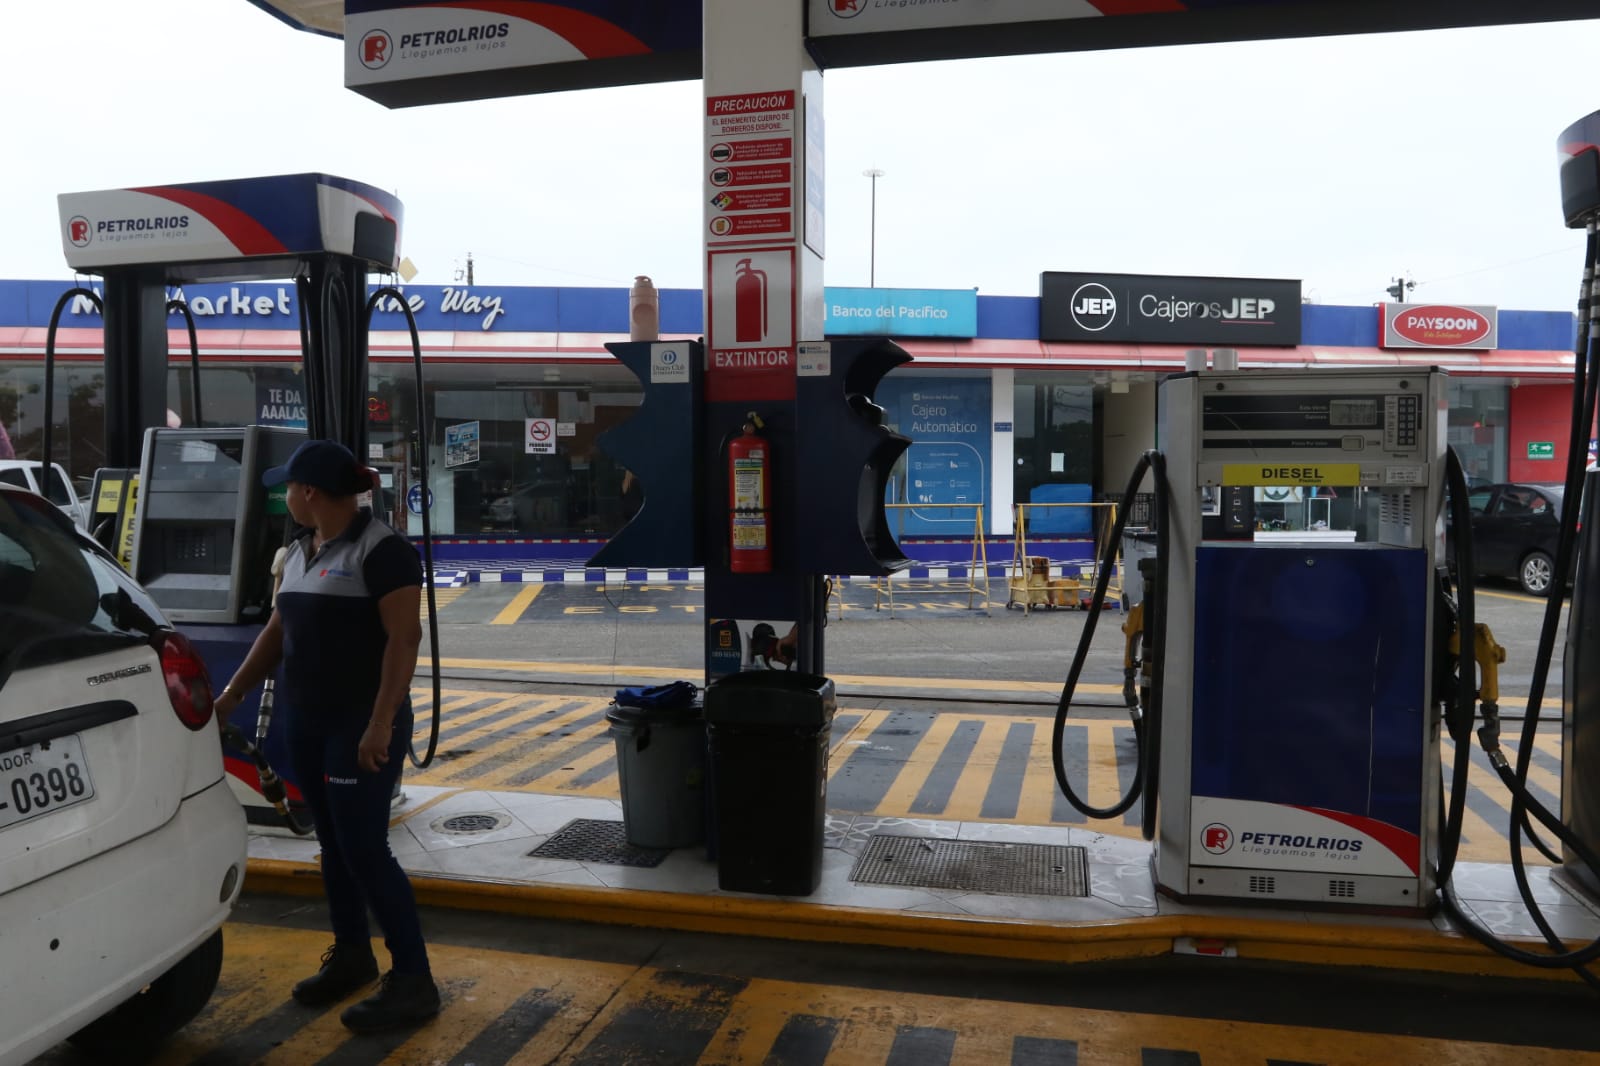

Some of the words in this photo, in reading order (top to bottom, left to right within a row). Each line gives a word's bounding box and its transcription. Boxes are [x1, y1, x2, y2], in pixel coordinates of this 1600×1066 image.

[400, 23, 509, 49] PETROLRIOS
[401, 44, 467, 59] Lleguemos
[475, 40, 506, 53] lejos
[713, 94, 787, 112] PRECAUCIÓN
[757, 114, 781, 122] CUERPO
[721, 124, 755, 133] BOMBEROS
[97, 215, 189, 233] PETROLRIOS
[99, 231, 156, 243] Lleguemos
[162, 229, 188, 240] lejos
[440, 287, 505, 330] Way
[832, 305, 872, 318] Banco
[875, 305, 896, 318] del
[899, 305, 949, 319] Pacífico
[1074, 297, 1115, 315] JEP
[1407, 316, 1478, 331] PAYSOON
[715, 350, 788, 368] EXTINTOR
[268, 389, 283, 404] TE
[285, 390, 302, 404] DA
[261, 404, 306, 420] AAALAS
[911, 404, 947, 419] Cajero
[911, 421, 977, 433] Automático
[1261, 468, 1324, 479] DIESEL
[1240, 831, 1363, 852] PETROLRIOS
[1242, 845, 1316, 858] Lleguemos
[1325, 851, 1359, 862] lejos
